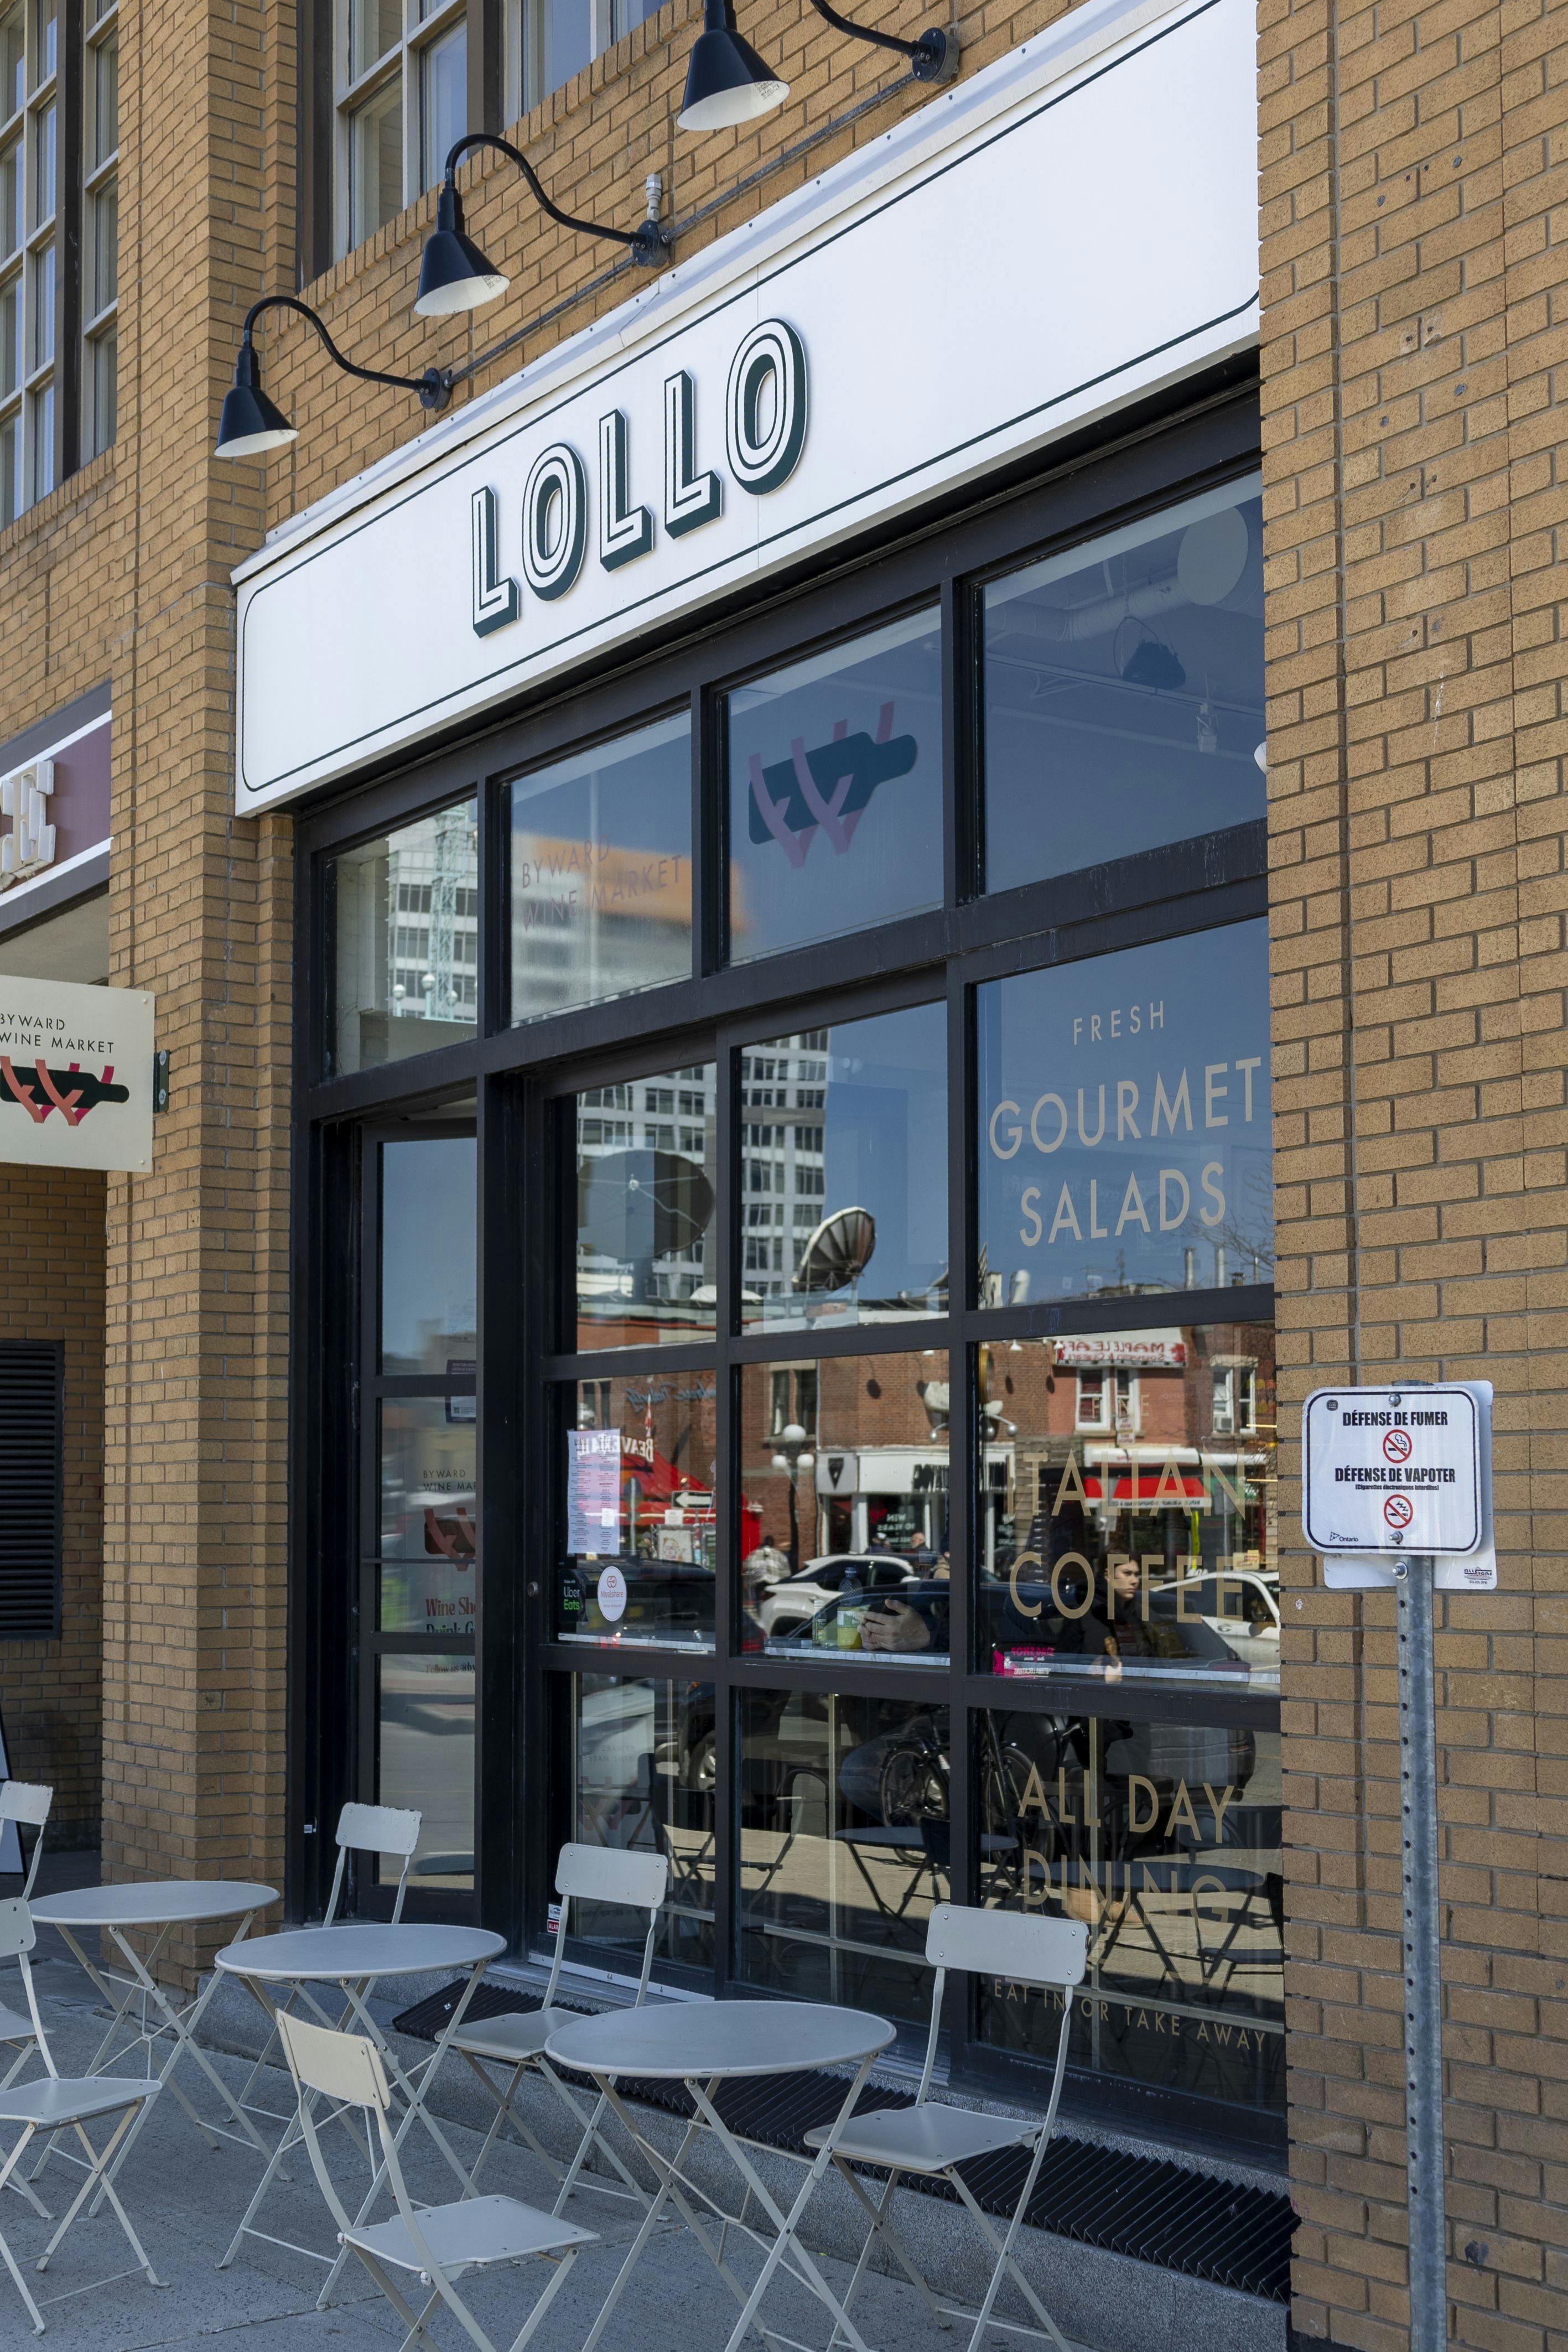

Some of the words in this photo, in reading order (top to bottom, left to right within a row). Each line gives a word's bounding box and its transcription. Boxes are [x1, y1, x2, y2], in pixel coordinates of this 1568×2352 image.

[471, 318, 807, 638] LOLLO
[522, 835, 609, 889] BYWARD
[525, 890, 577, 932] WINE
[592, 854, 681, 909] MARKET
[0, 1032, 41, 1046] WINE
[51, 1037, 114, 1053] MARKET
[1074, 1001, 1164, 1045] FRESH
[989, 1056, 1261, 1160] GOURMET
[1020, 1161, 1226, 1247] SALADS
[1092, 1394, 1149, 1419] FNE
[1343, 1410, 1392, 1426] DÉFENSE
[1394, 1412, 1408, 1426] DE
[1411, 1411, 1448, 1425] FUMER
[423, 1469, 466, 1478] BYWARD
[423, 1482, 451, 1491] WINE
[1007, 1445, 1245, 1520] ITALIAN
[1335, 1465, 1386, 1482] DÉFENSE
[1389, 1468, 1402, 1482] DE
[1404, 1468, 1455, 1483] VAPOTER
[425, 1598, 455, 1617] Wine
[564, 1587, 580, 1598] Uber
[564, 1599, 580, 1610] Eats
[1010, 1551, 1243, 1626] COFFEE
[425, 1664, 449, 1674] Follow
[1018, 1762, 1100, 1827] ALL
[1129, 1774, 1234, 1844] DAY
[1024, 1850, 1229, 1935] DINING
[995, 1979, 1029, 2003] EAT
[1044, 1992, 1066, 2010] IN
[1081, 1999, 1108, 2021] OR
[1124, 2005, 1180, 2036] TAKE
[1197, 2021, 1265, 2052] AWAY
